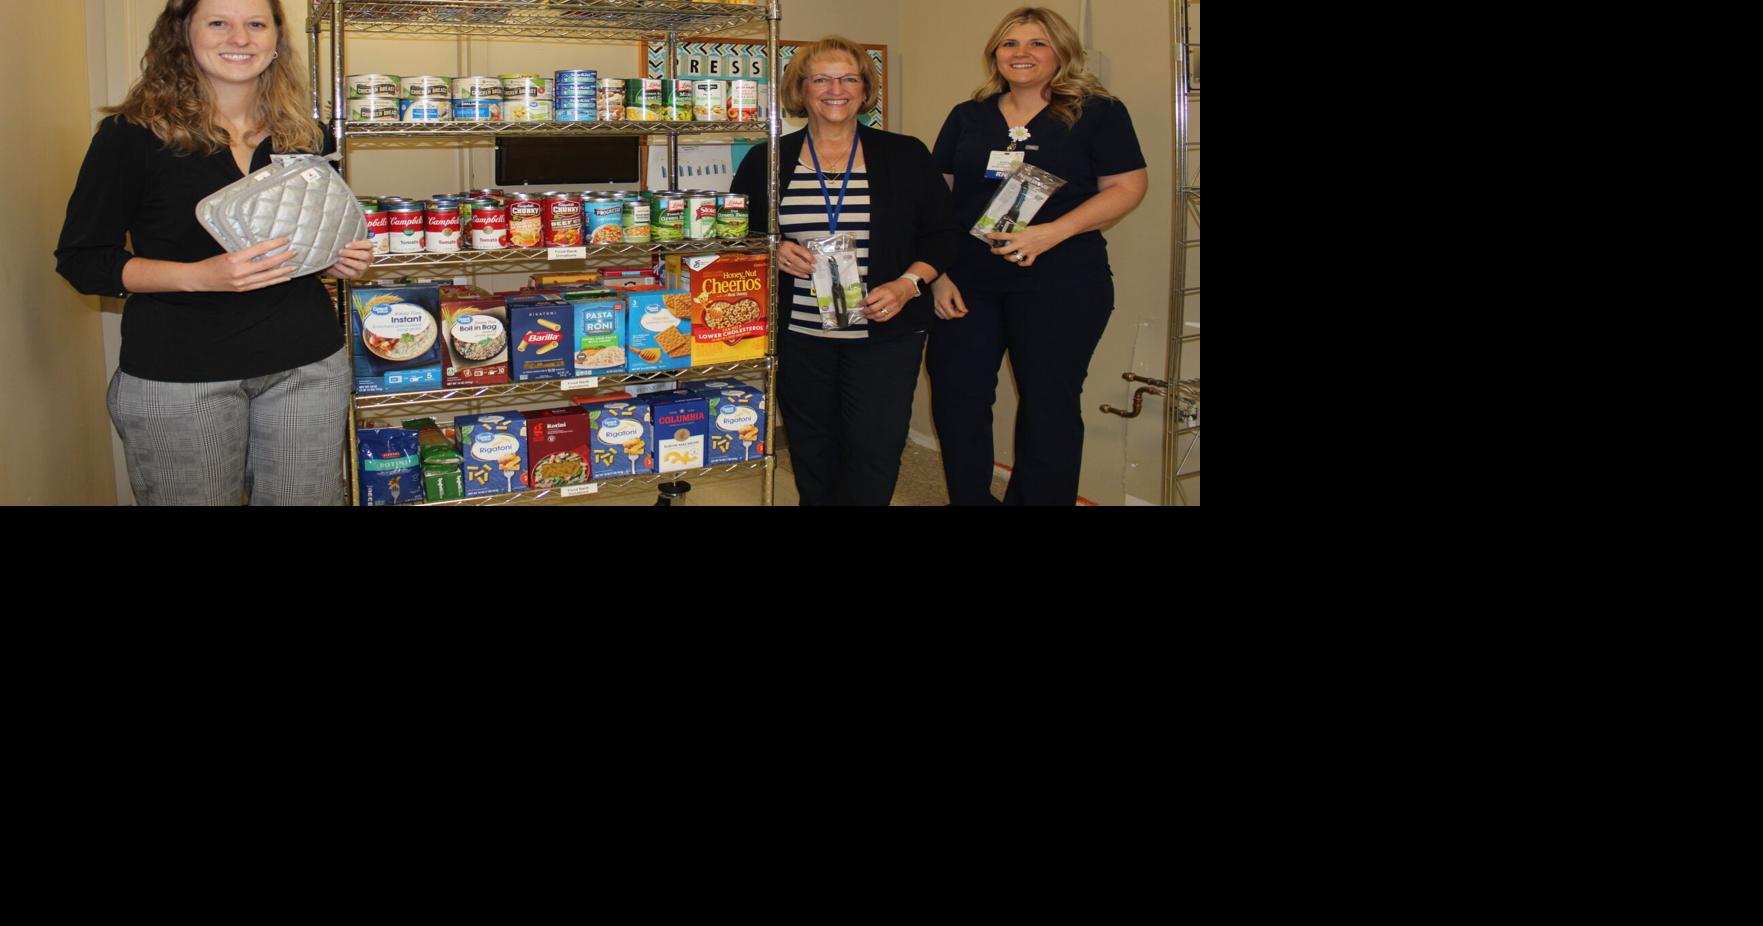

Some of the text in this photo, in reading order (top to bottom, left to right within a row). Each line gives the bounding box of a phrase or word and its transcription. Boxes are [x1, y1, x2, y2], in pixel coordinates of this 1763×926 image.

[512, 206, 539, 214] CHUNKY
[553, 205, 579, 213] CHUNKY
[723, 270, 757, 280] Honey Nut
[702, 278, 762, 294] Cheerios
[391, 315, 422, 323] Instant
[585, 311, 613, 320] PASTA
[586, 322, 613, 331] RONI
[722, 325, 764, 337] CHOLESTEROL
[528, 333, 560, 342] Barilla
[658, 412, 704, 425] COLUMBIA
[723, 415, 752, 425] Rigatoni
[605, 428, 637, 438] Rigatoni
[479, 443, 513, 454] Rigatoni
